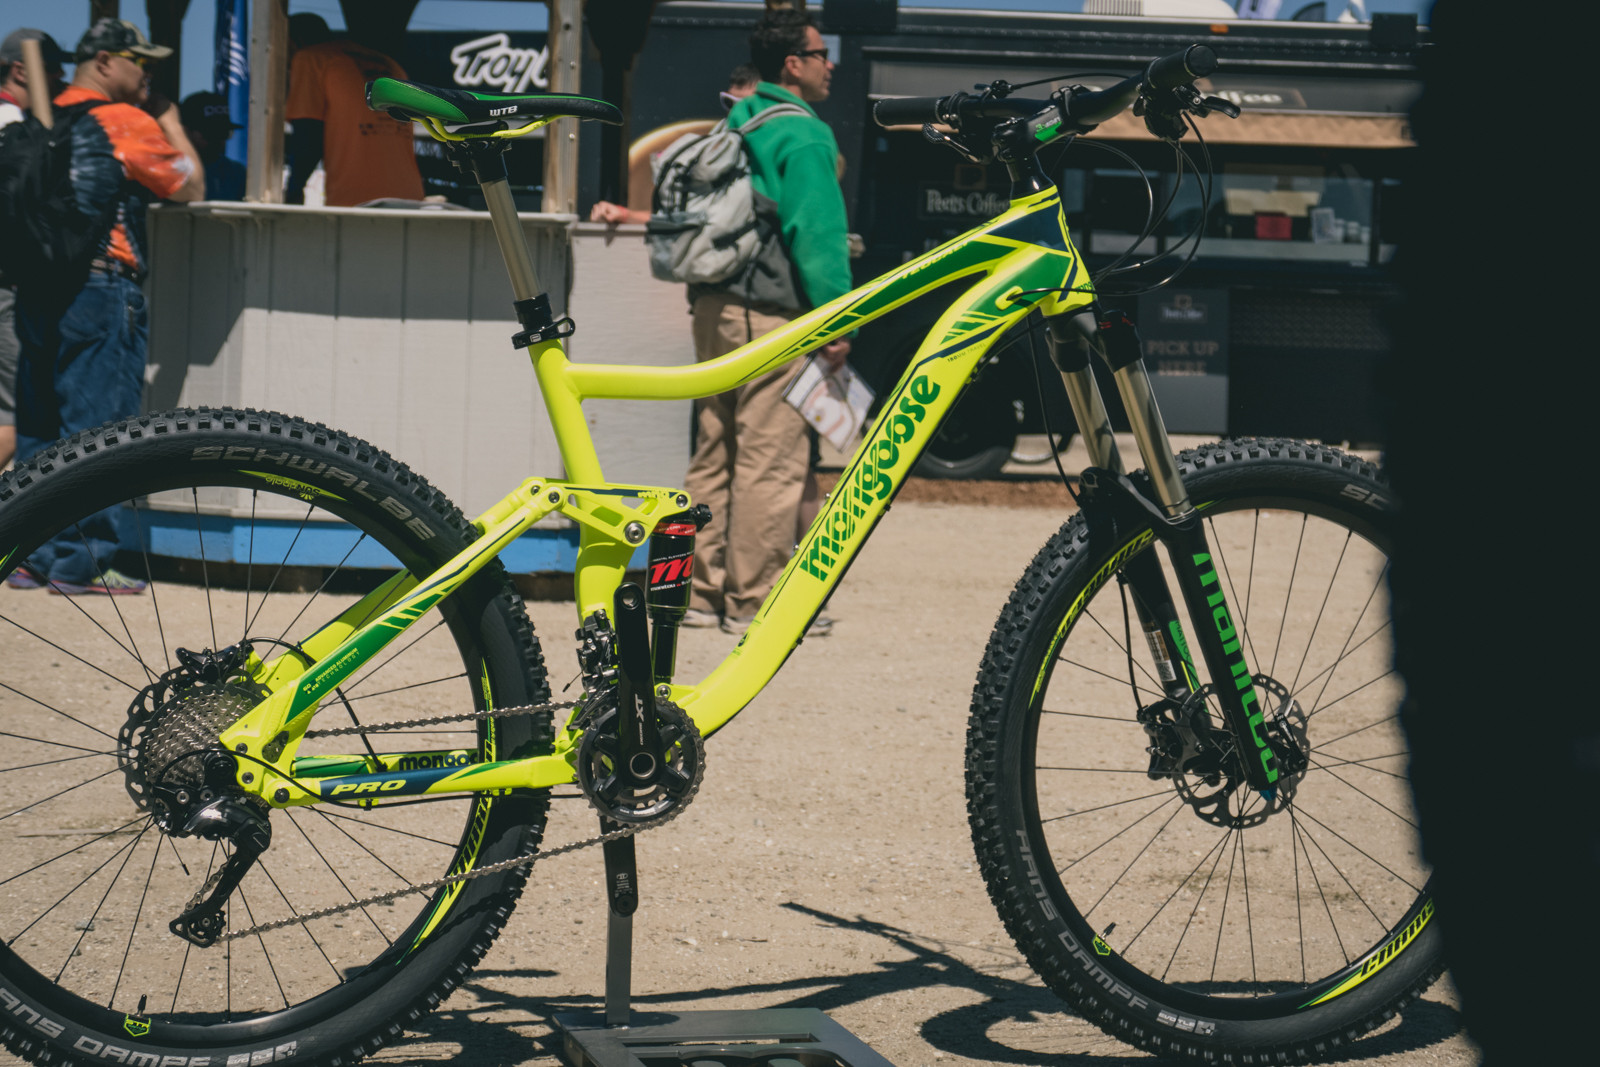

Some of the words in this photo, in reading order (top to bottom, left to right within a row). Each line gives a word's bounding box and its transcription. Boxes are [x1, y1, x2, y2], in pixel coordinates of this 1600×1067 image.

[489, 105, 518, 116] WTB
[1193, 341, 1219, 356] UP
[190, 446, 436, 541] SCHWALBE
[799, 375, 941, 582] mongoose
[315, 664, 337, 683] ADVANCED
[336, 647, 358, 666] ALUMINUM
[318, 651, 360, 687] TECHNOLOGY
[1192, 552, 1279, 784] manitou
[634, 693, 645, 722] XT
[330, 779, 407, 796] PRO
[1015, 829, 1058, 921] HANS
[1058, 930, 1149, 1010] DAMPF
[0, 986, 66, 1039] ANS
